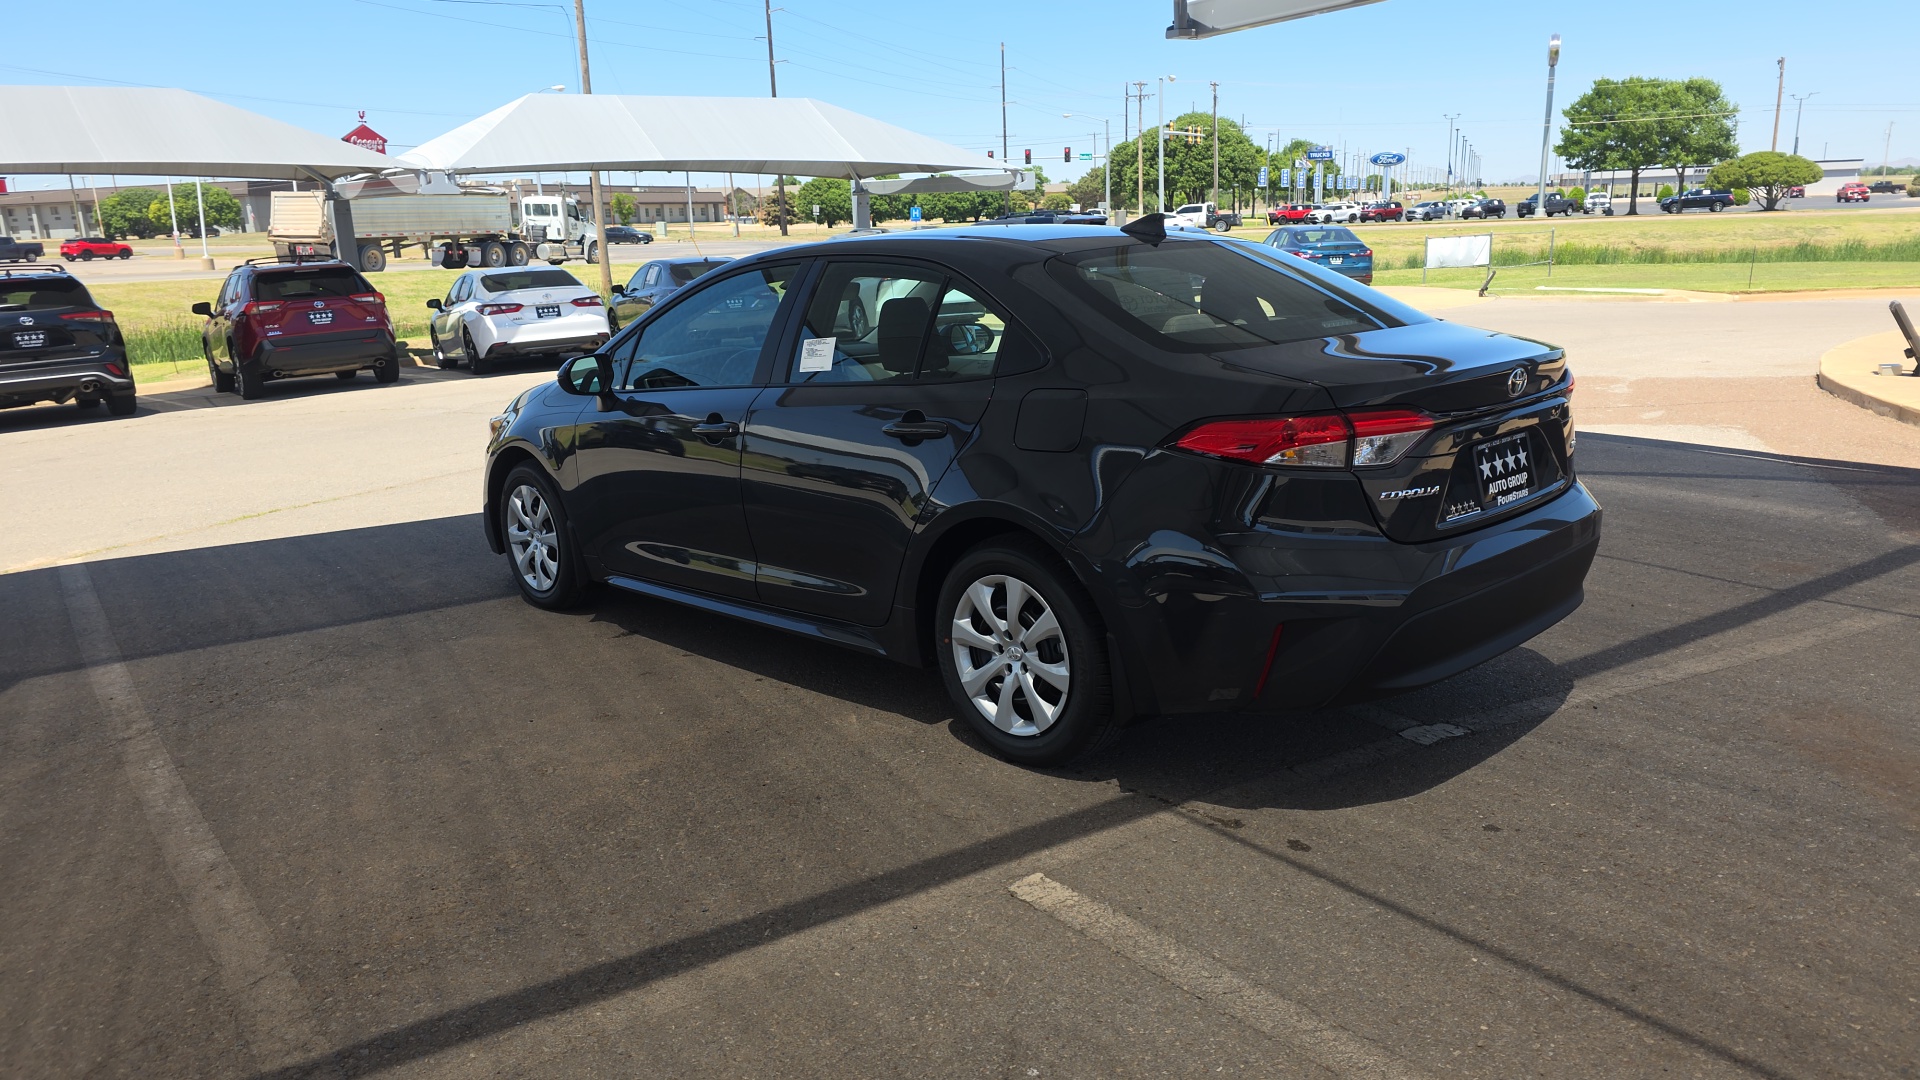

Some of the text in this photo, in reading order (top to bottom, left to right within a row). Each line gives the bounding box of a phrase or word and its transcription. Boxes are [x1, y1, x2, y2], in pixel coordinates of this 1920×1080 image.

[1377, 154, 1399, 164] Ford
[1488, 471, 1528, 495] AUTO GROUP
[1379, 485, 1440, 500] COROLLA
